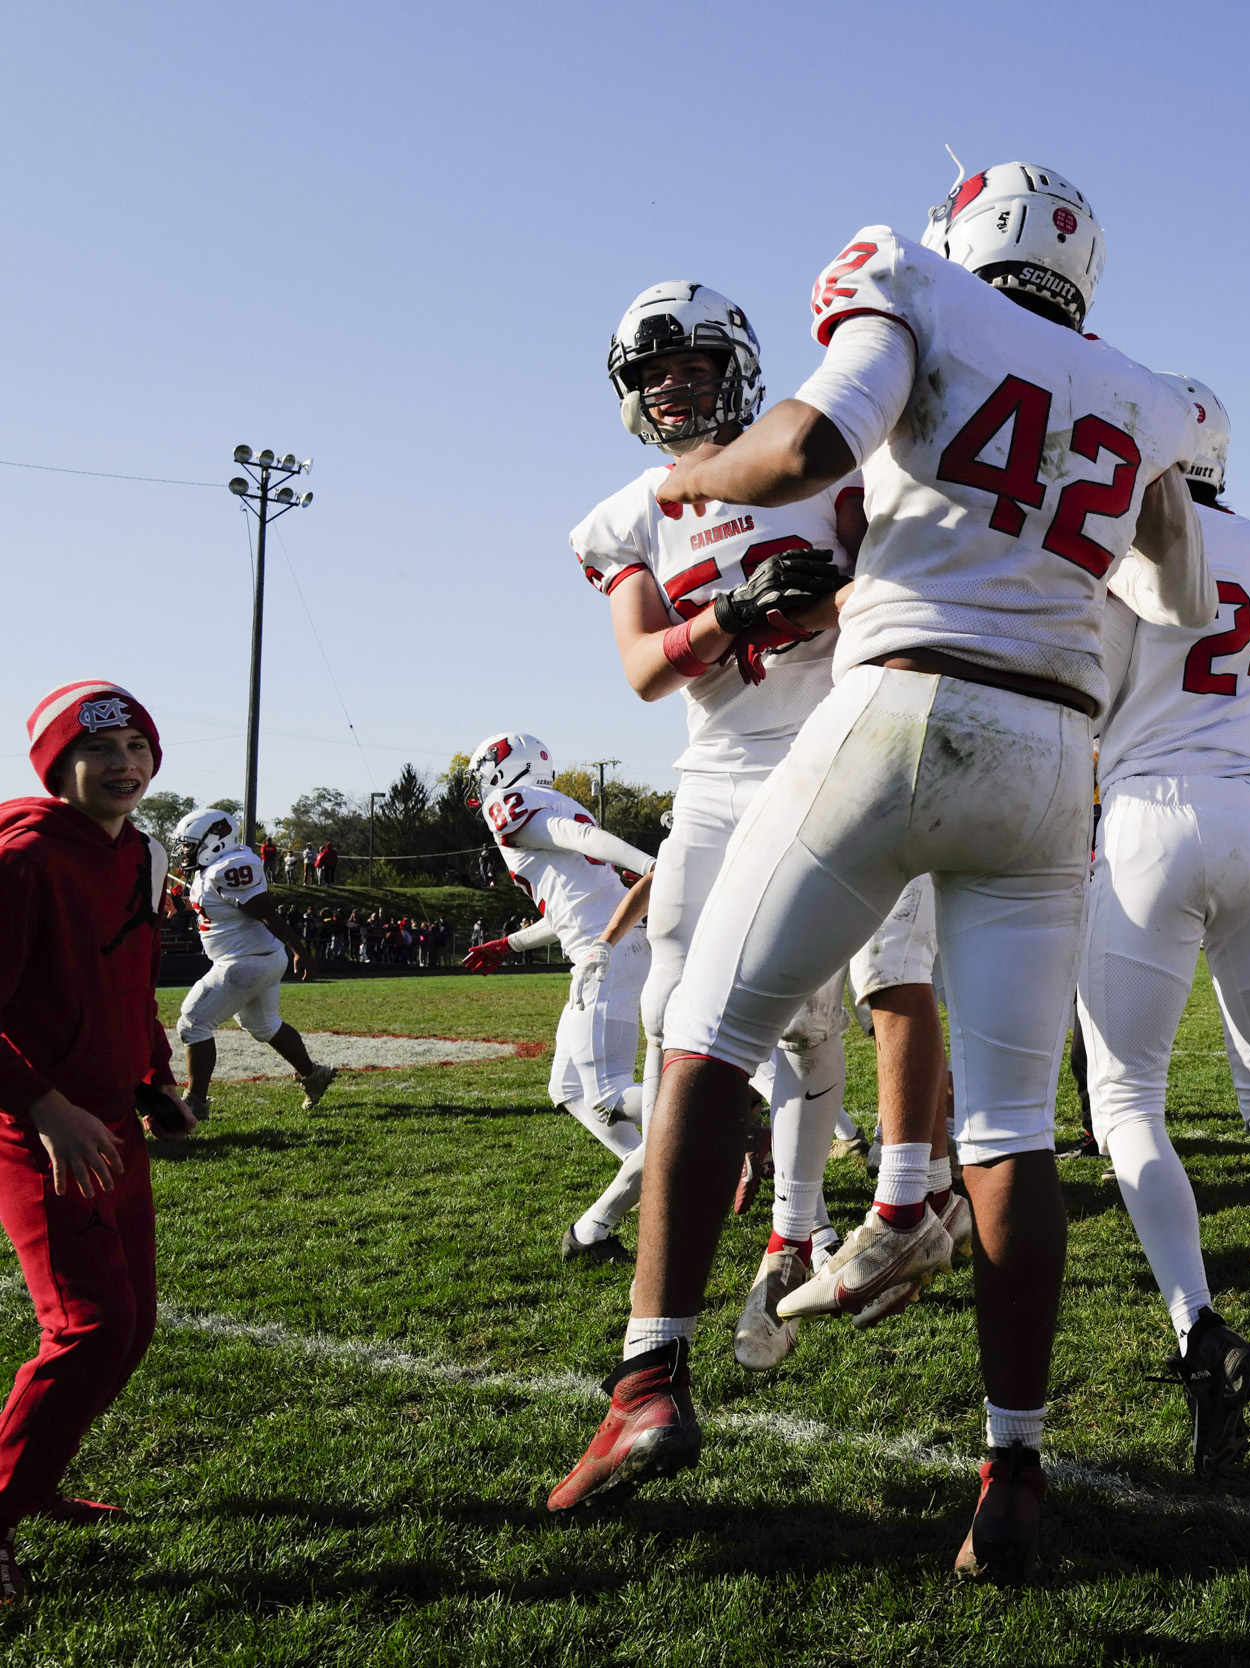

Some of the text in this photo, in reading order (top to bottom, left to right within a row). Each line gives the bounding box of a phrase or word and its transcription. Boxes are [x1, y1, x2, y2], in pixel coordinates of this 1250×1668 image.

[1019, 267, 1076, 300] schutt
[936, 374, 1142, 581] 42
[690, 514, 755, 551] CARDINALS
[488, 792, 529, 832] 82
[224, 865, 254, 888] 99
